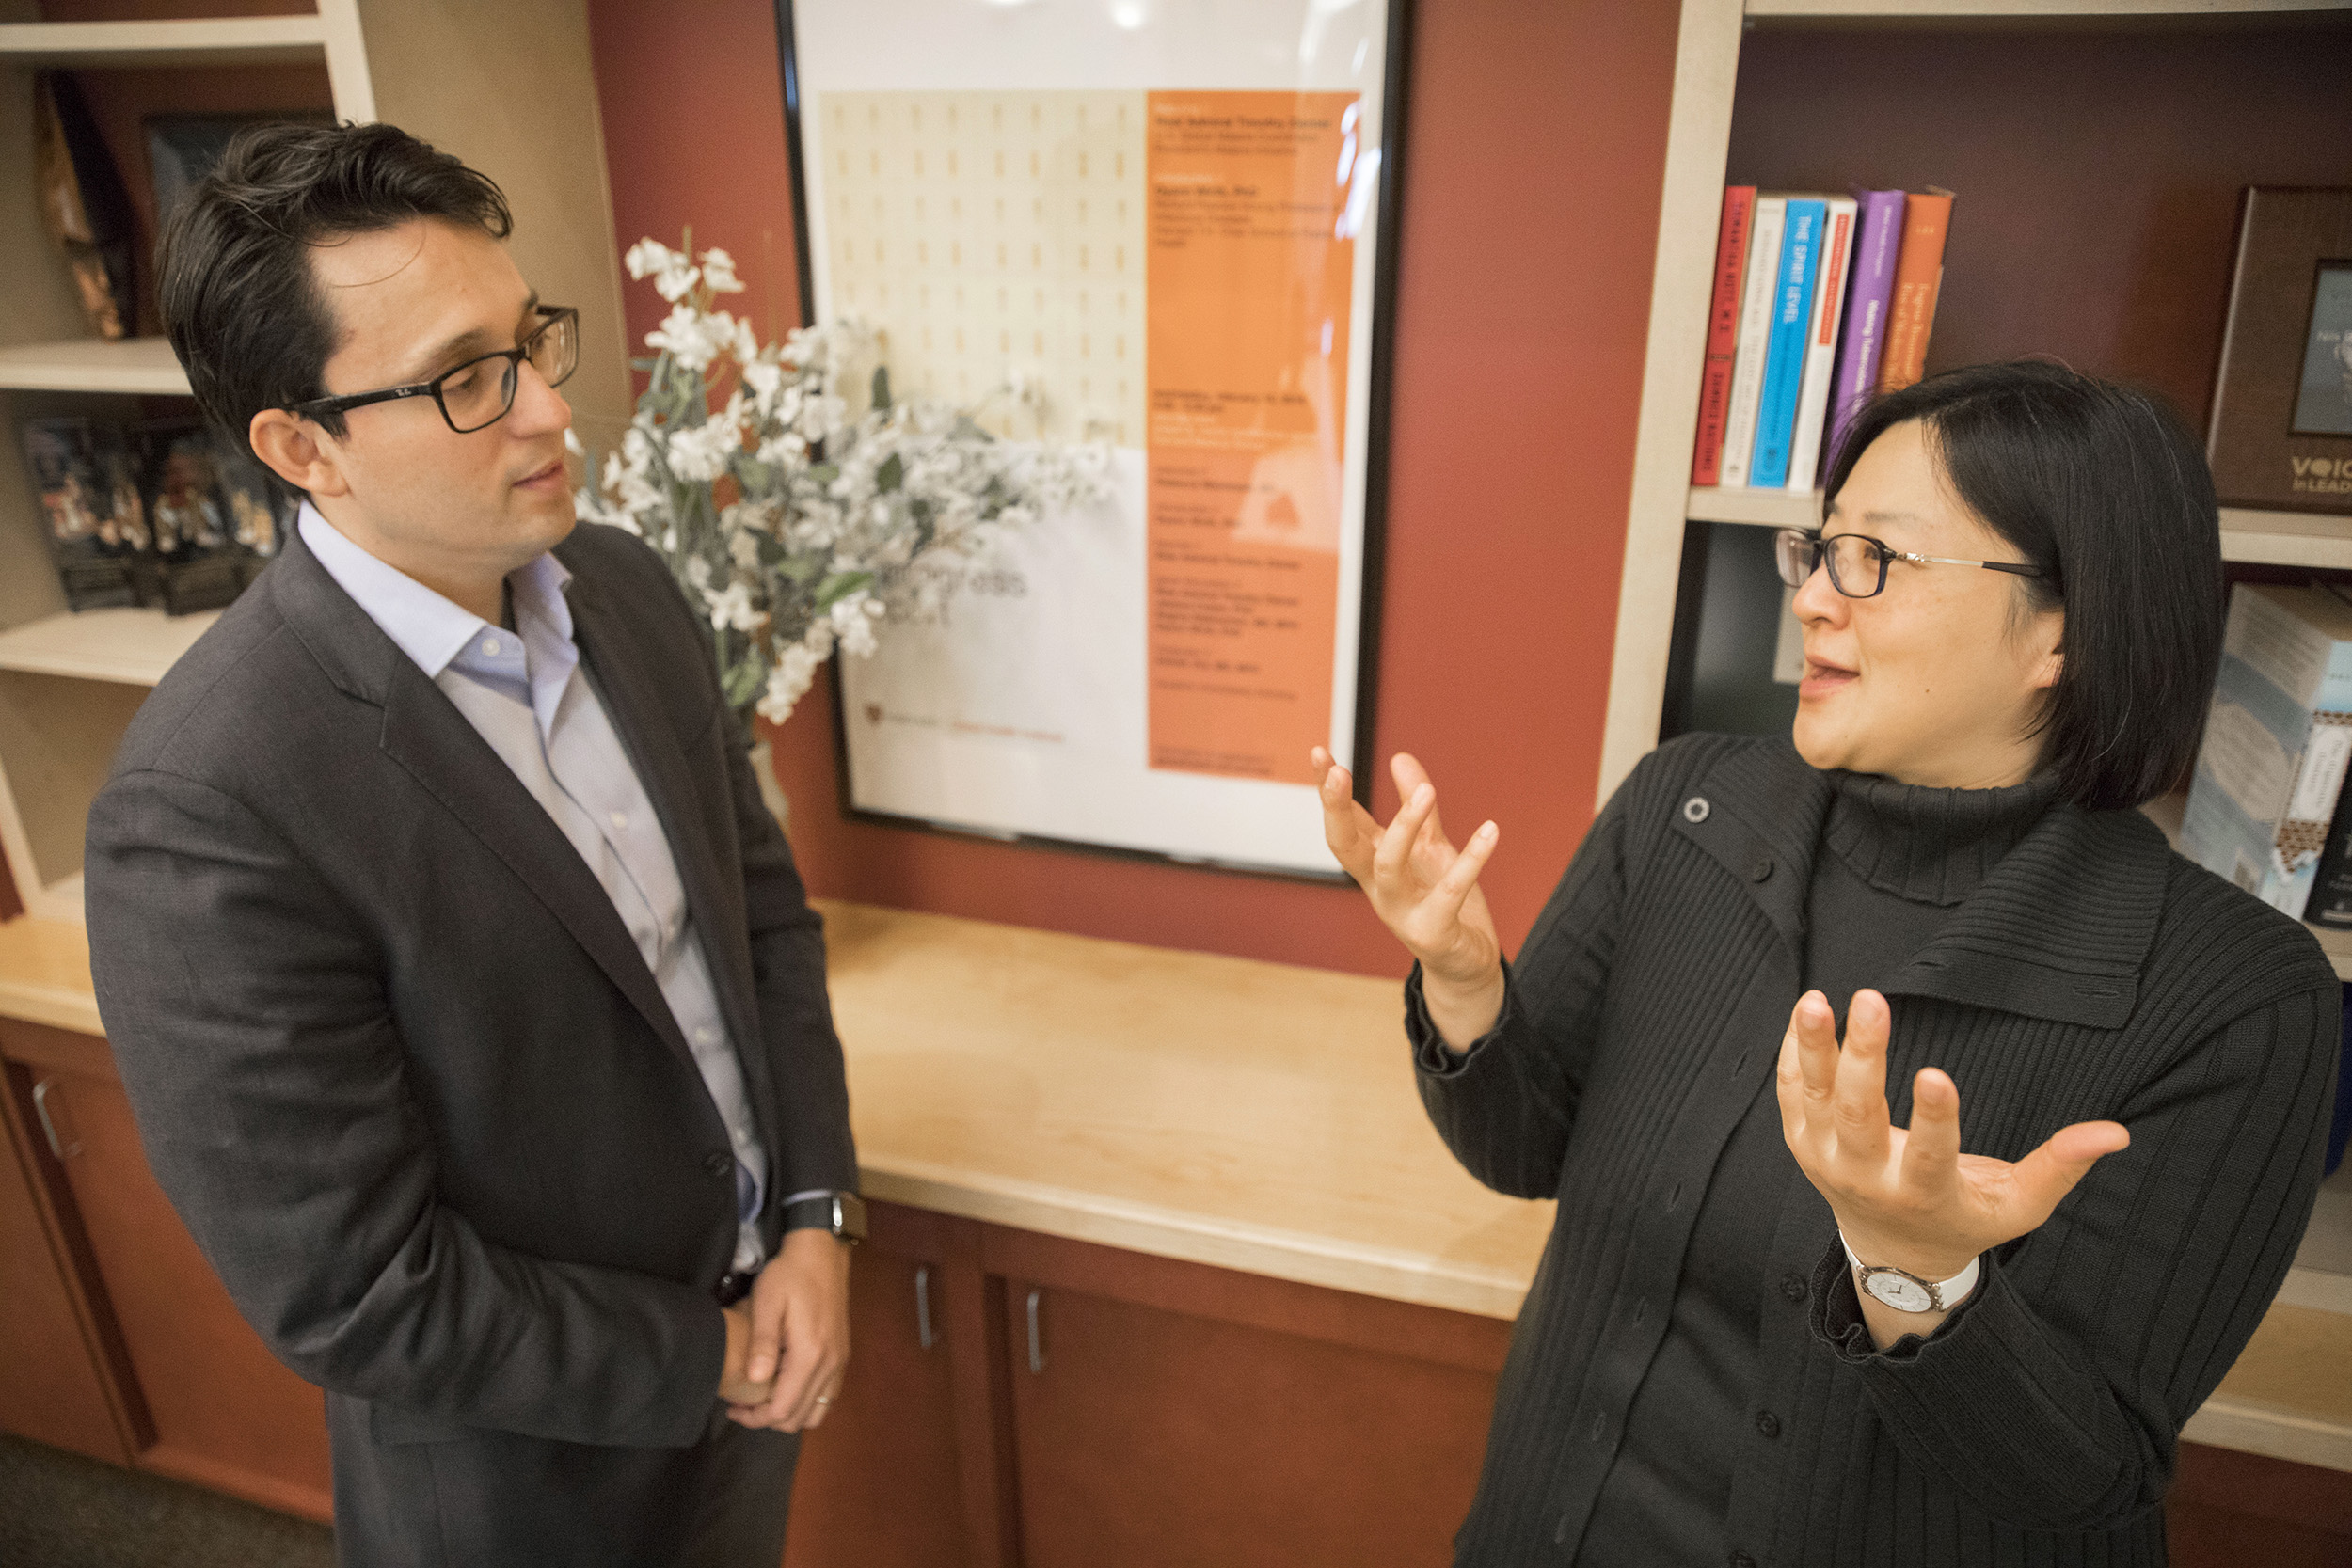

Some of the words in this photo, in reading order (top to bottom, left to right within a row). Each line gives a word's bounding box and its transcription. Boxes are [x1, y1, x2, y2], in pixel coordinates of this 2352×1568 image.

[1795, 215, 1812, 241] THE
[1790, 244, 1807, 284] SPIRIT
[1783, 285, 1802, 324] LEVEL
